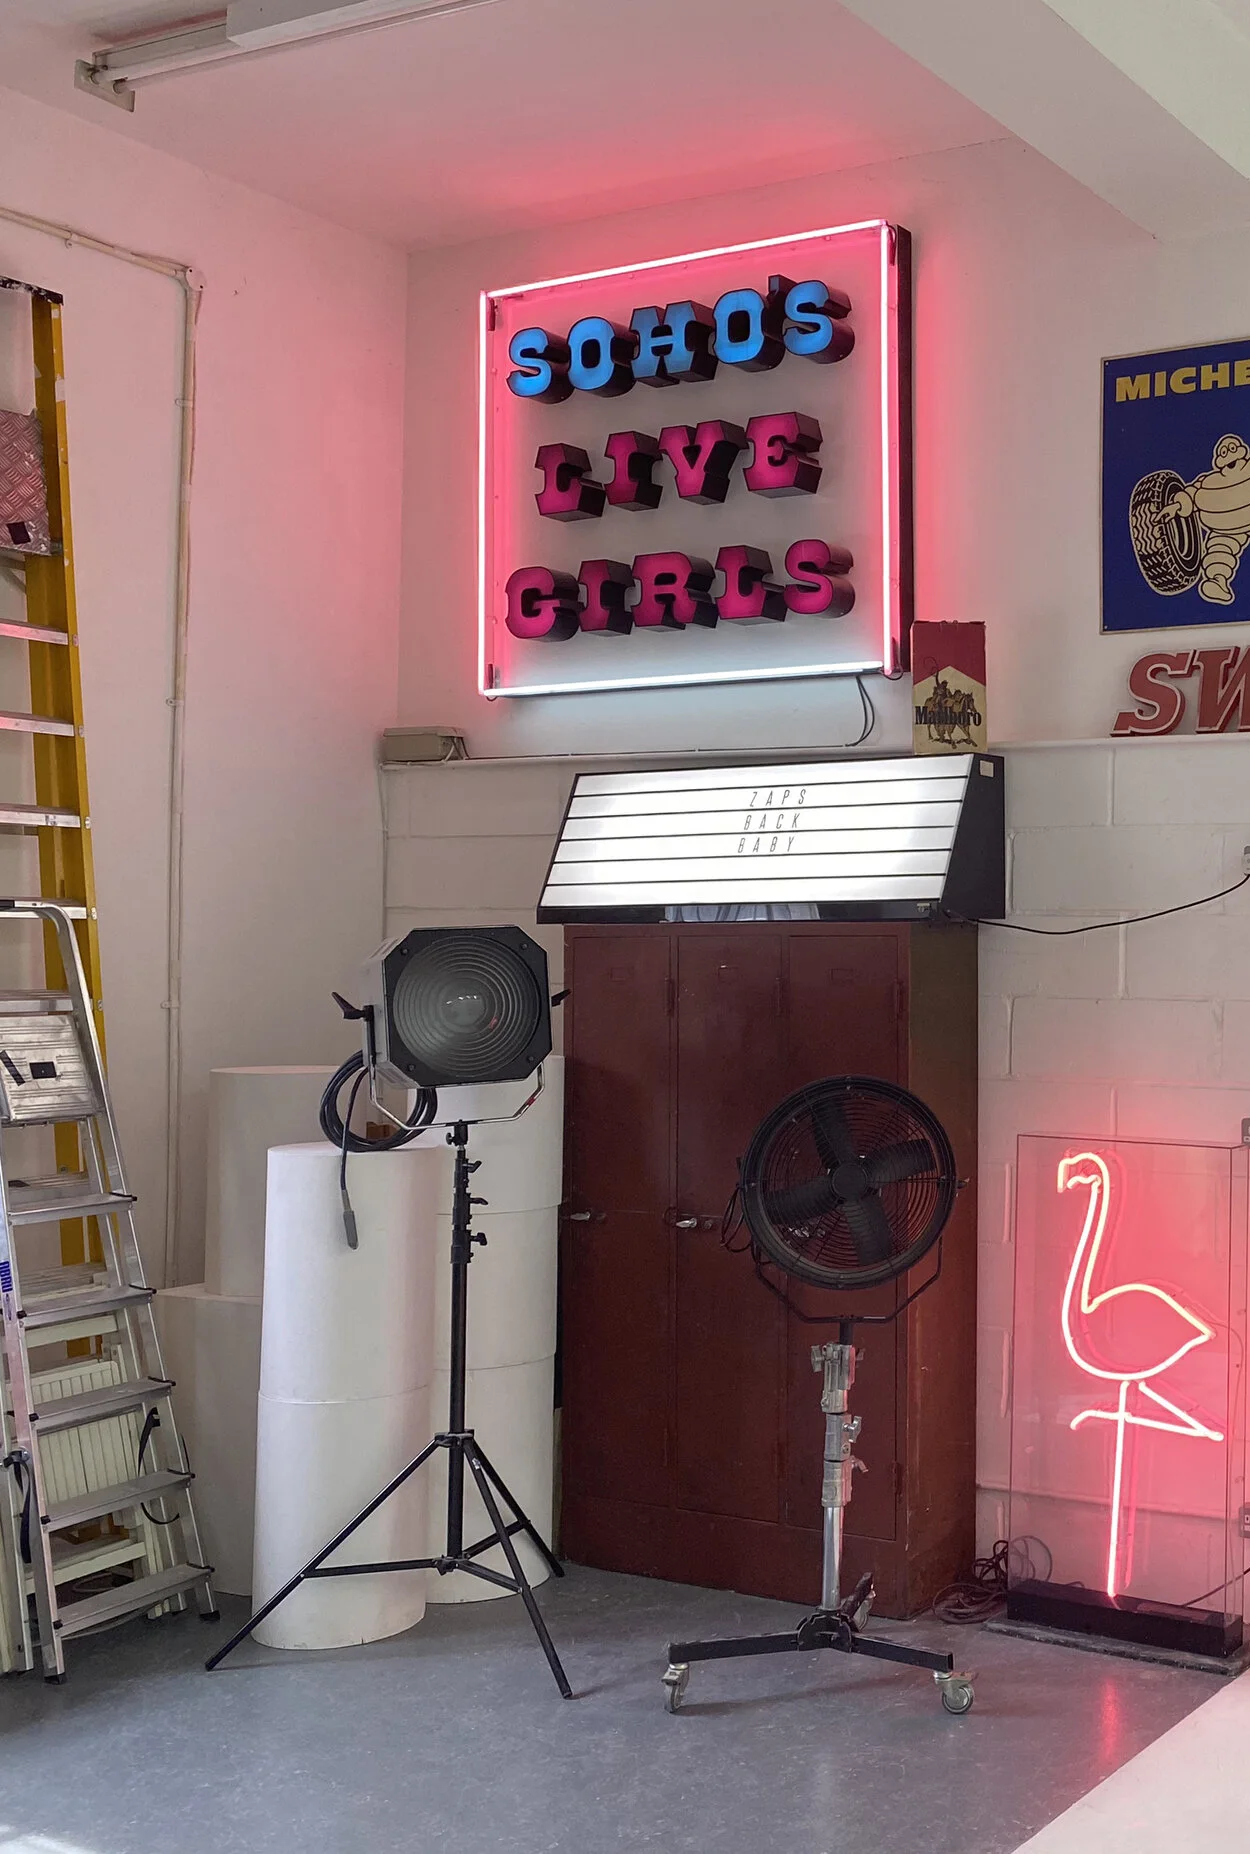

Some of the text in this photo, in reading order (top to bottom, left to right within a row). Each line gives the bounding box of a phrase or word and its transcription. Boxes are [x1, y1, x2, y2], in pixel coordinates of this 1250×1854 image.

[507, 275, 854, 403] SOHO'S
[535, 412, 823, 521] LIVE
[505, 539, 855, 641] GIRLS
[744, 813, 800, 830] BACK
[749, 789, 806, 807] ZAPS
[738, 836, 794, 853] BABY
